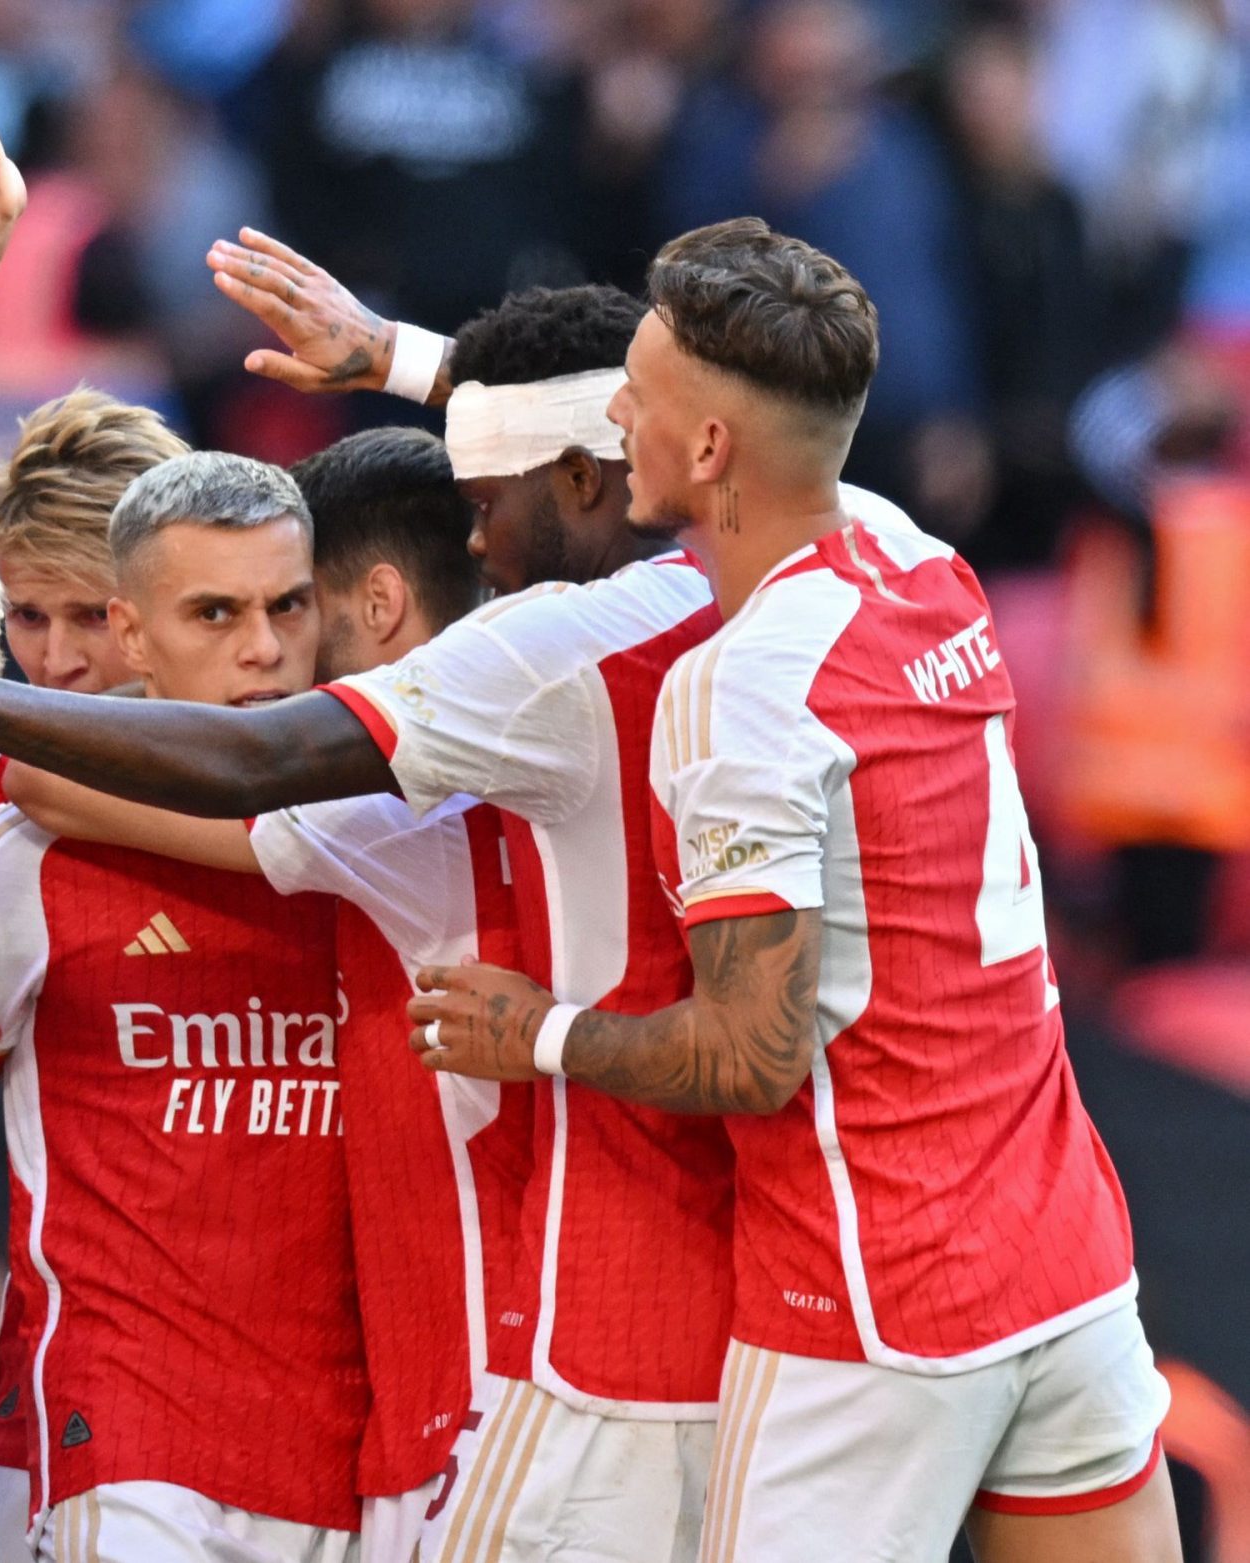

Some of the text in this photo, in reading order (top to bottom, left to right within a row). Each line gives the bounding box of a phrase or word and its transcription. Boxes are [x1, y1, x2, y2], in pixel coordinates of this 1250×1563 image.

[902, 614, 1000, 704] WHITE
[976, 713, 1061, 1014] 4
[110, 996, 337, 1069] Emira
[162, 1078, 344, 1136] FLY BETT
